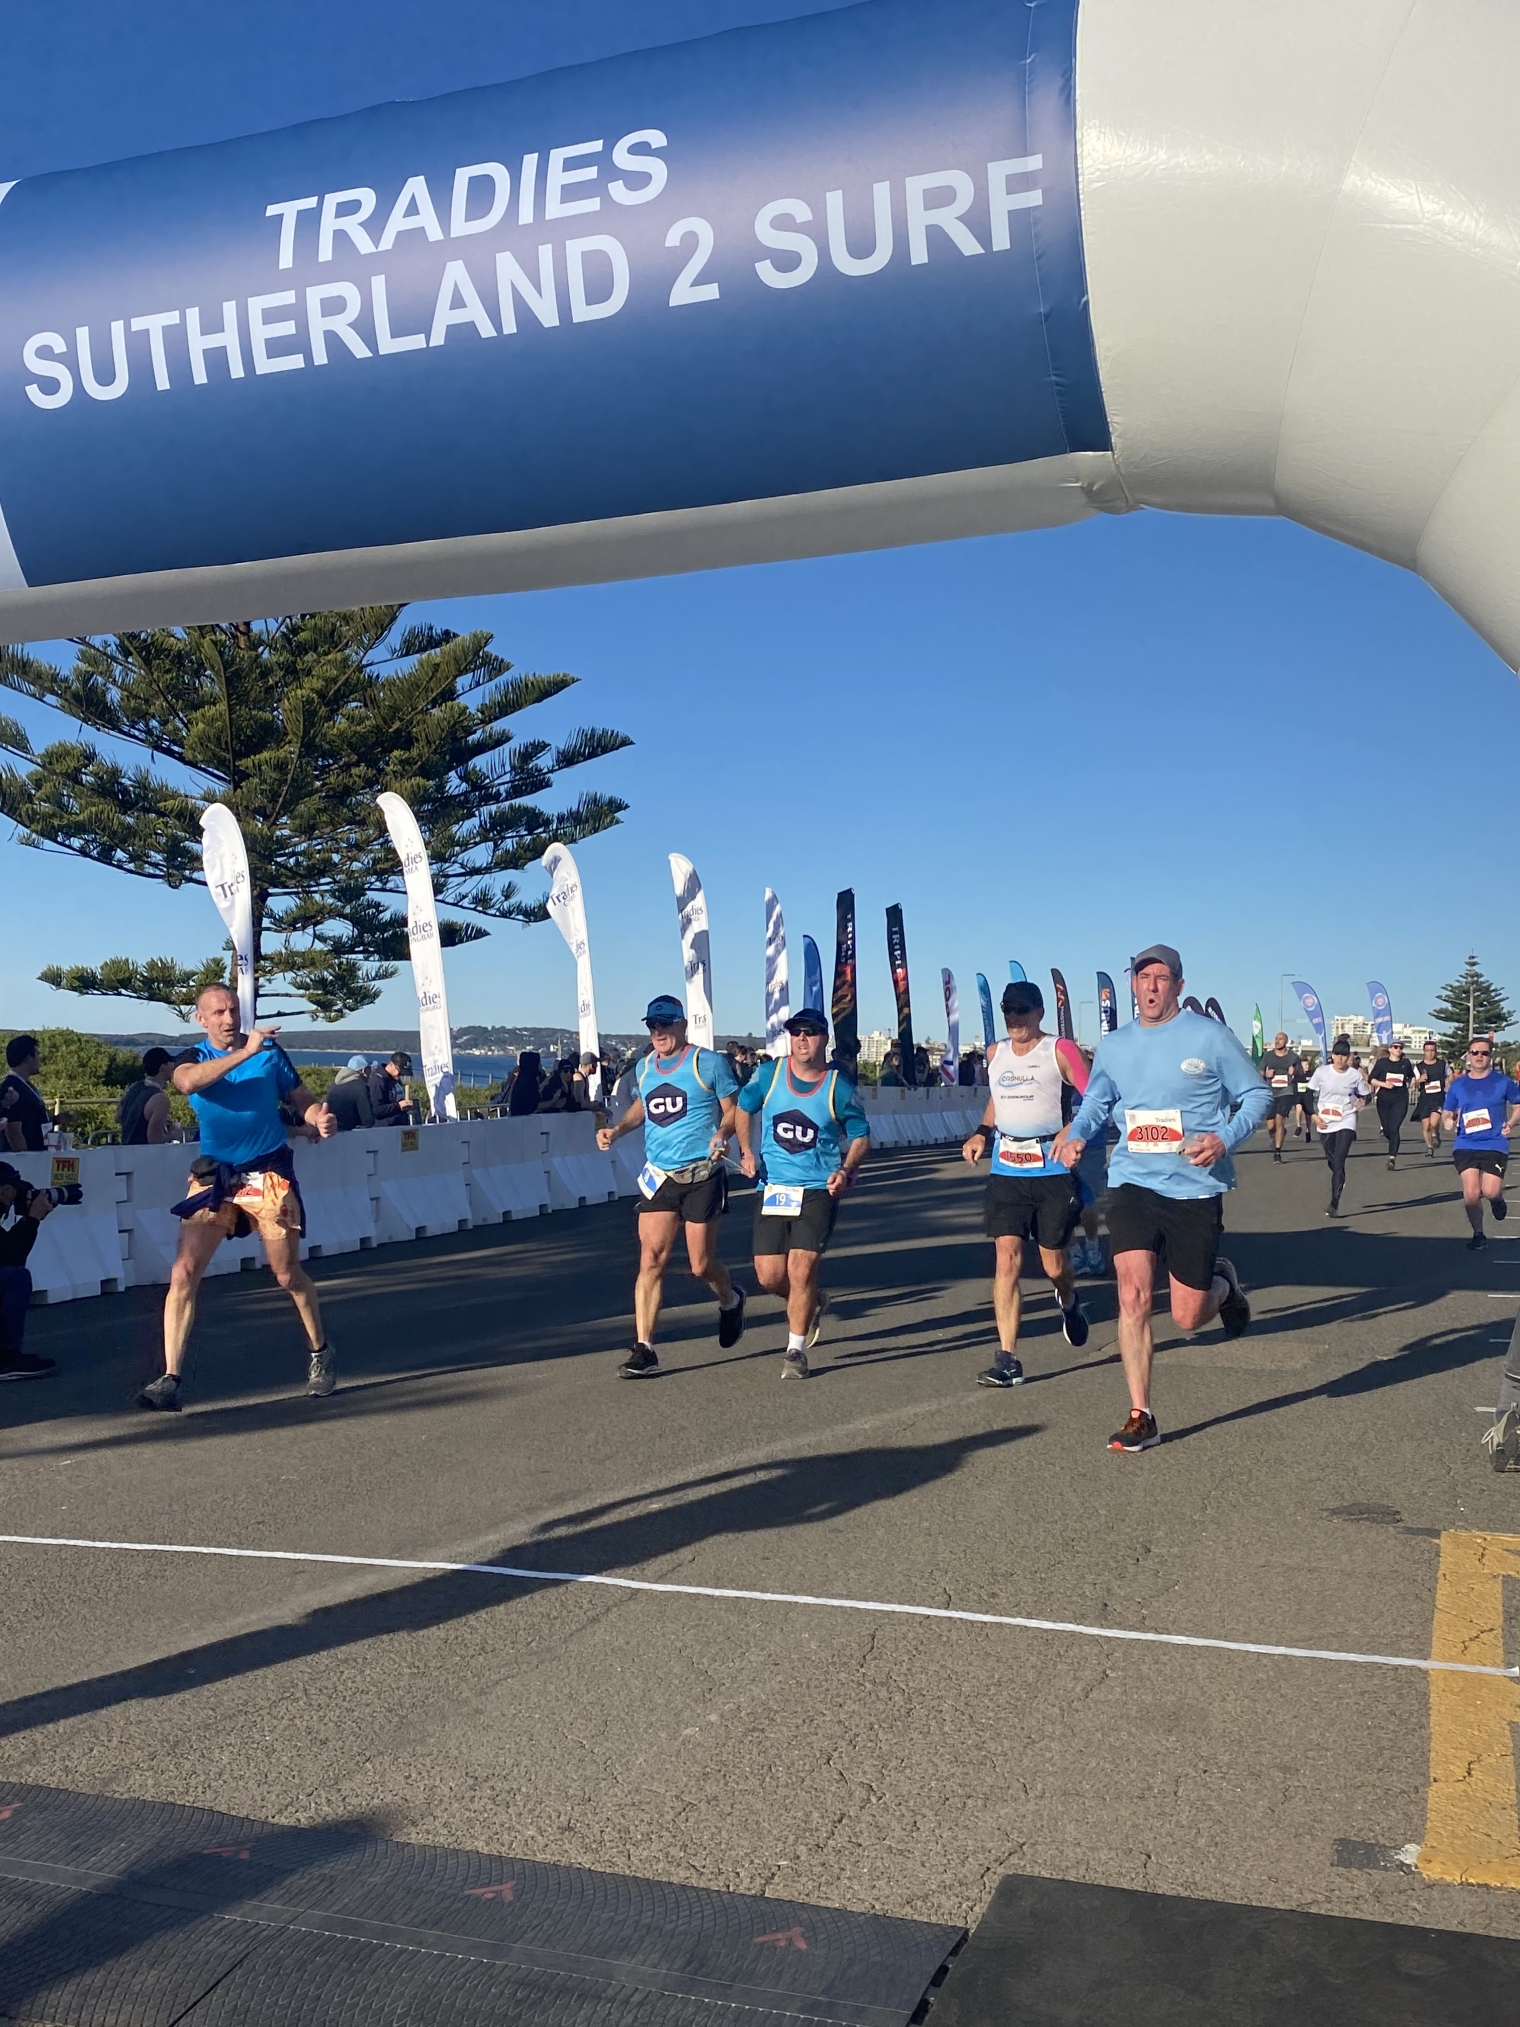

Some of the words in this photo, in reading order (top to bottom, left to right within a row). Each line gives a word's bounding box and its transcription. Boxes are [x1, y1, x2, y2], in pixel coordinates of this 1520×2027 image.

[265, 128, 669, 269] TRADIES
[22, 233, 630, 410] SUTHERLAND
[664, 216, 720, 306] 2
[754, 153, 1043, 289] SURF
[403, 852, 423, 868] dies
[648, 1096, 684, 1115] GU
[776, 1122, 815, 1143] GU
[1135, 1126, 1169, 1141] 3102
[775, 1193, 787, 1206] 19
